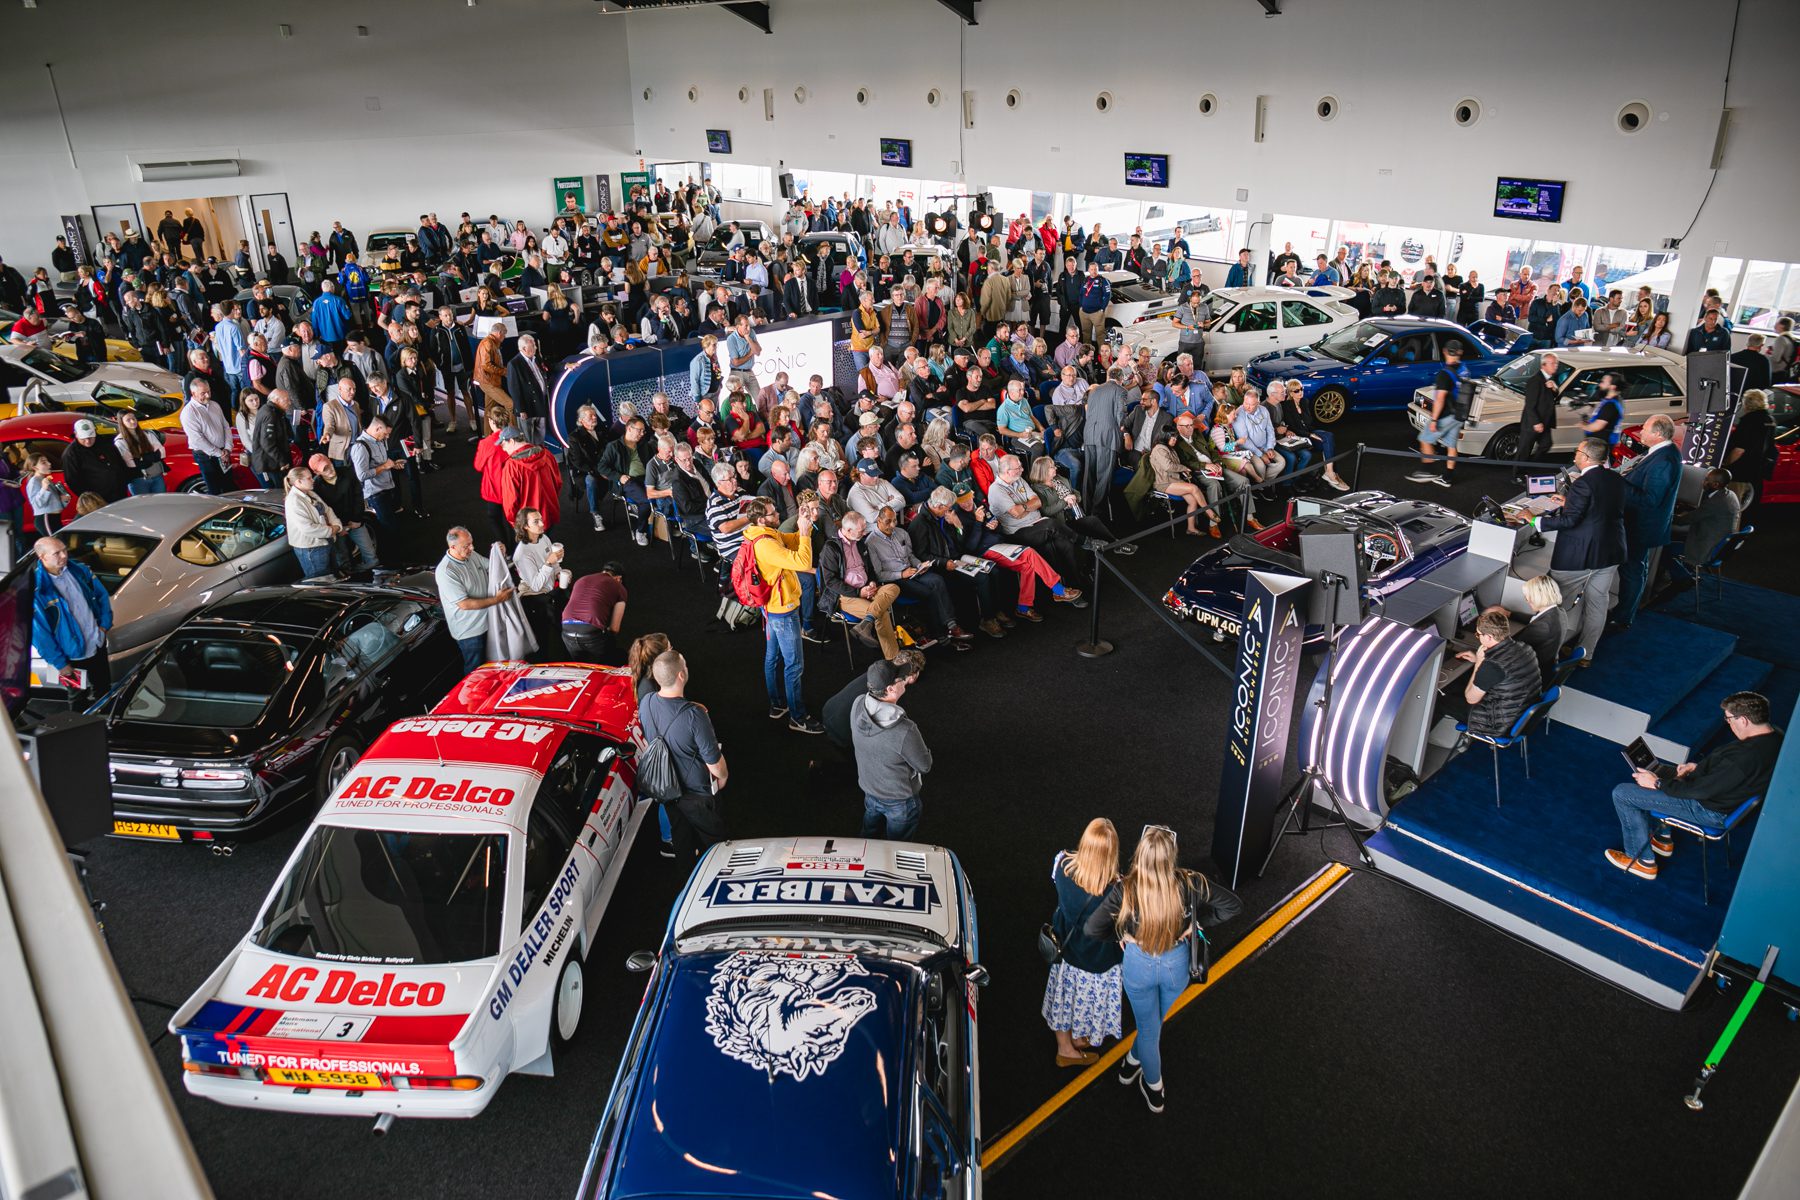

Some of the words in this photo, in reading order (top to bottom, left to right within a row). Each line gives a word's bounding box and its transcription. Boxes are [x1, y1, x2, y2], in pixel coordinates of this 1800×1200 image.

[752, 352, 807, 377] CONIC
[1196, 609, 1219, 628] UPM
[502, 685, 559, 704] Delco
[557, 680, 584, 691] AC
[1233, 630, 1256, 738] ICONIC
[1243, 641, 1262, 746] AUCTIONEERS
[1262, 641, 1289, 747] ICONIC
[391, 719, 496, 738] Delco
[494, 722, 554, 744] AC
[339, 776, 402, 799] AC
[401, 776, 515, 806] Delco
[335, 800, 373, 808] TUNED
[374, 800, 401, 808] FOR
[401, 801, 507, 817] PROFESSIONALS.
[823, 839, 838, 854] 1
[727, 880, 916, 908] KALIBER
[489, 978, 513, 1021] GM
[508, 910, 555, 988] DEALER
[549, 857, 581, 916] SPORT
[542, 915, 574, 967] MICHELIN
[246, 963, 319, 1001] AC
[314, 969, 446, 1007] Delco
[336, 1021, 354, 1038] 3
[217, 1051, 266, 1067] TUNED
[268, 1056, 299, 1068] FOR
[300, 1057, 425, 1075] PROFESSIONALS.
[318, 1072, 369, 1085] 5958
